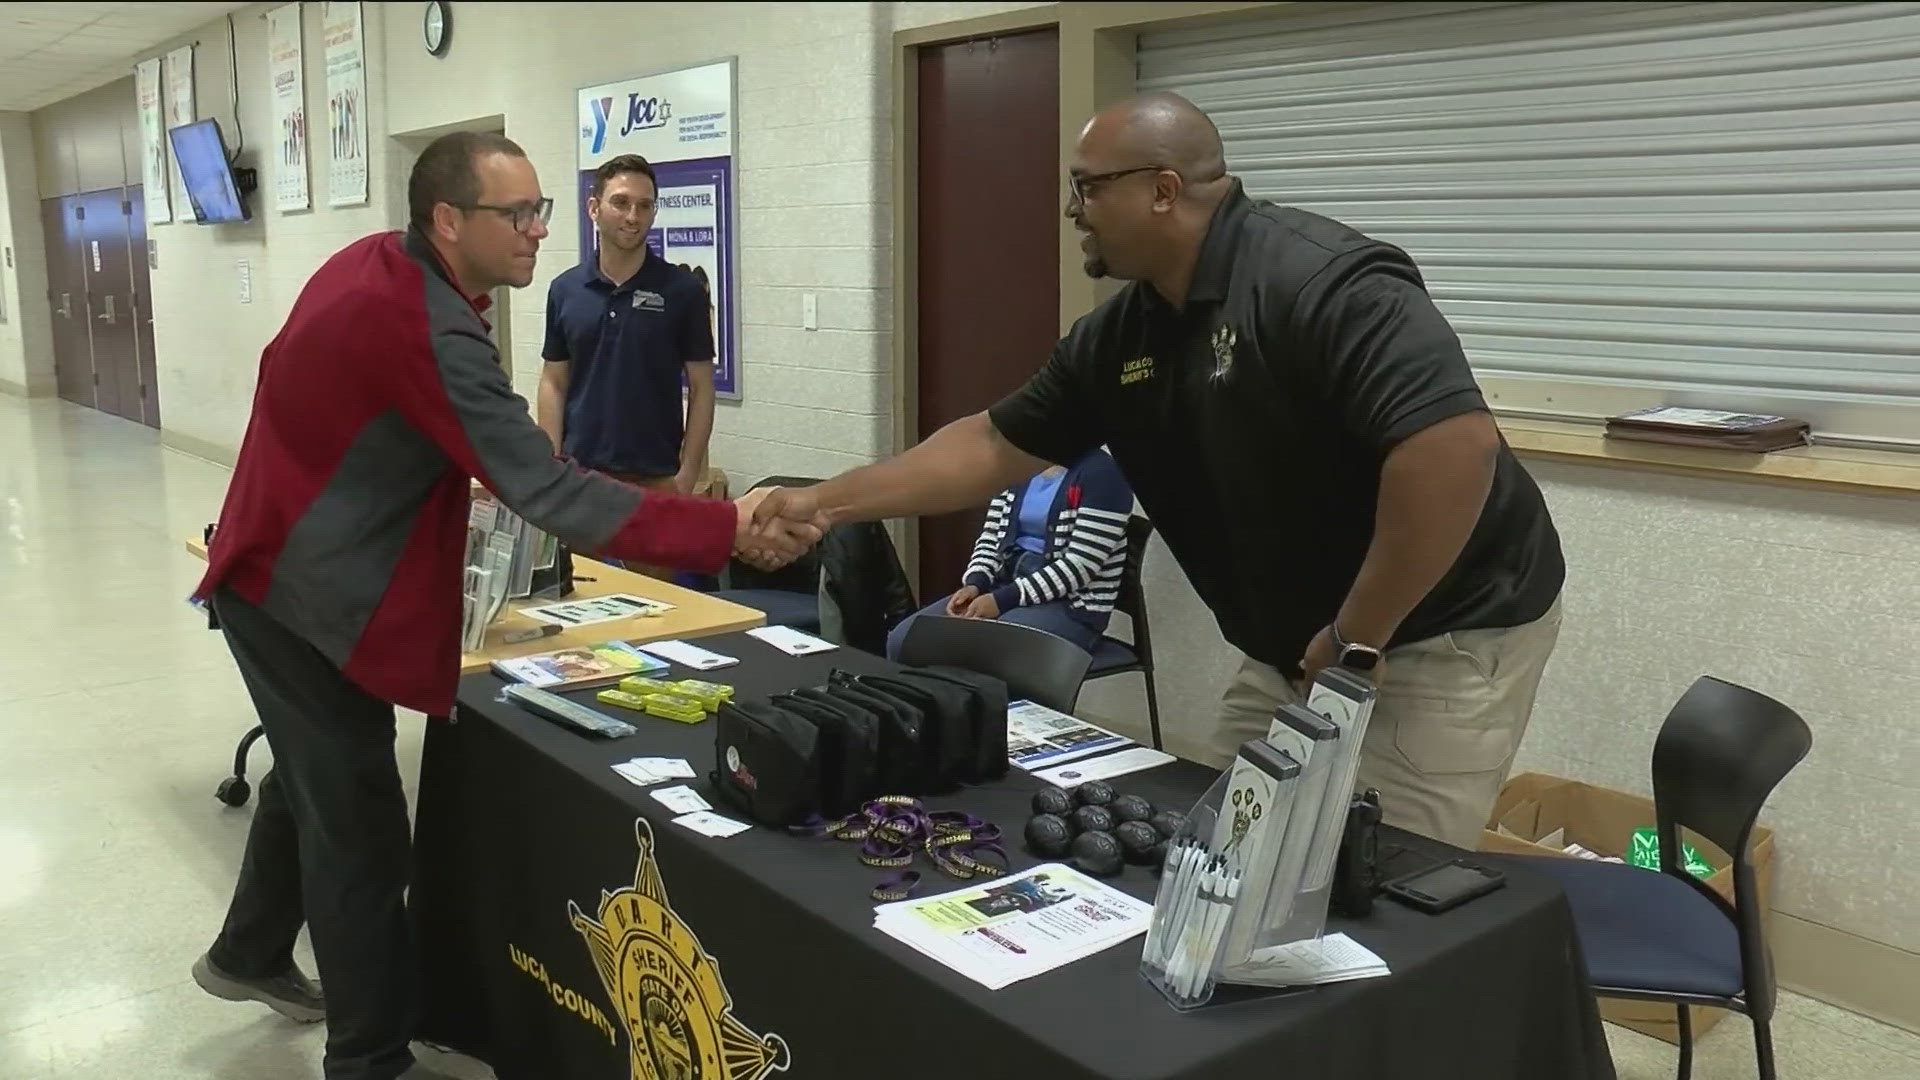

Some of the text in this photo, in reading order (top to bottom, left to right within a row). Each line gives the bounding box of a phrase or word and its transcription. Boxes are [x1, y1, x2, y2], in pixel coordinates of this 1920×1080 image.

[509, 943, 616, 1047] LUCA COUNTY
[632, 947, 695, 1006] SHERIFF
